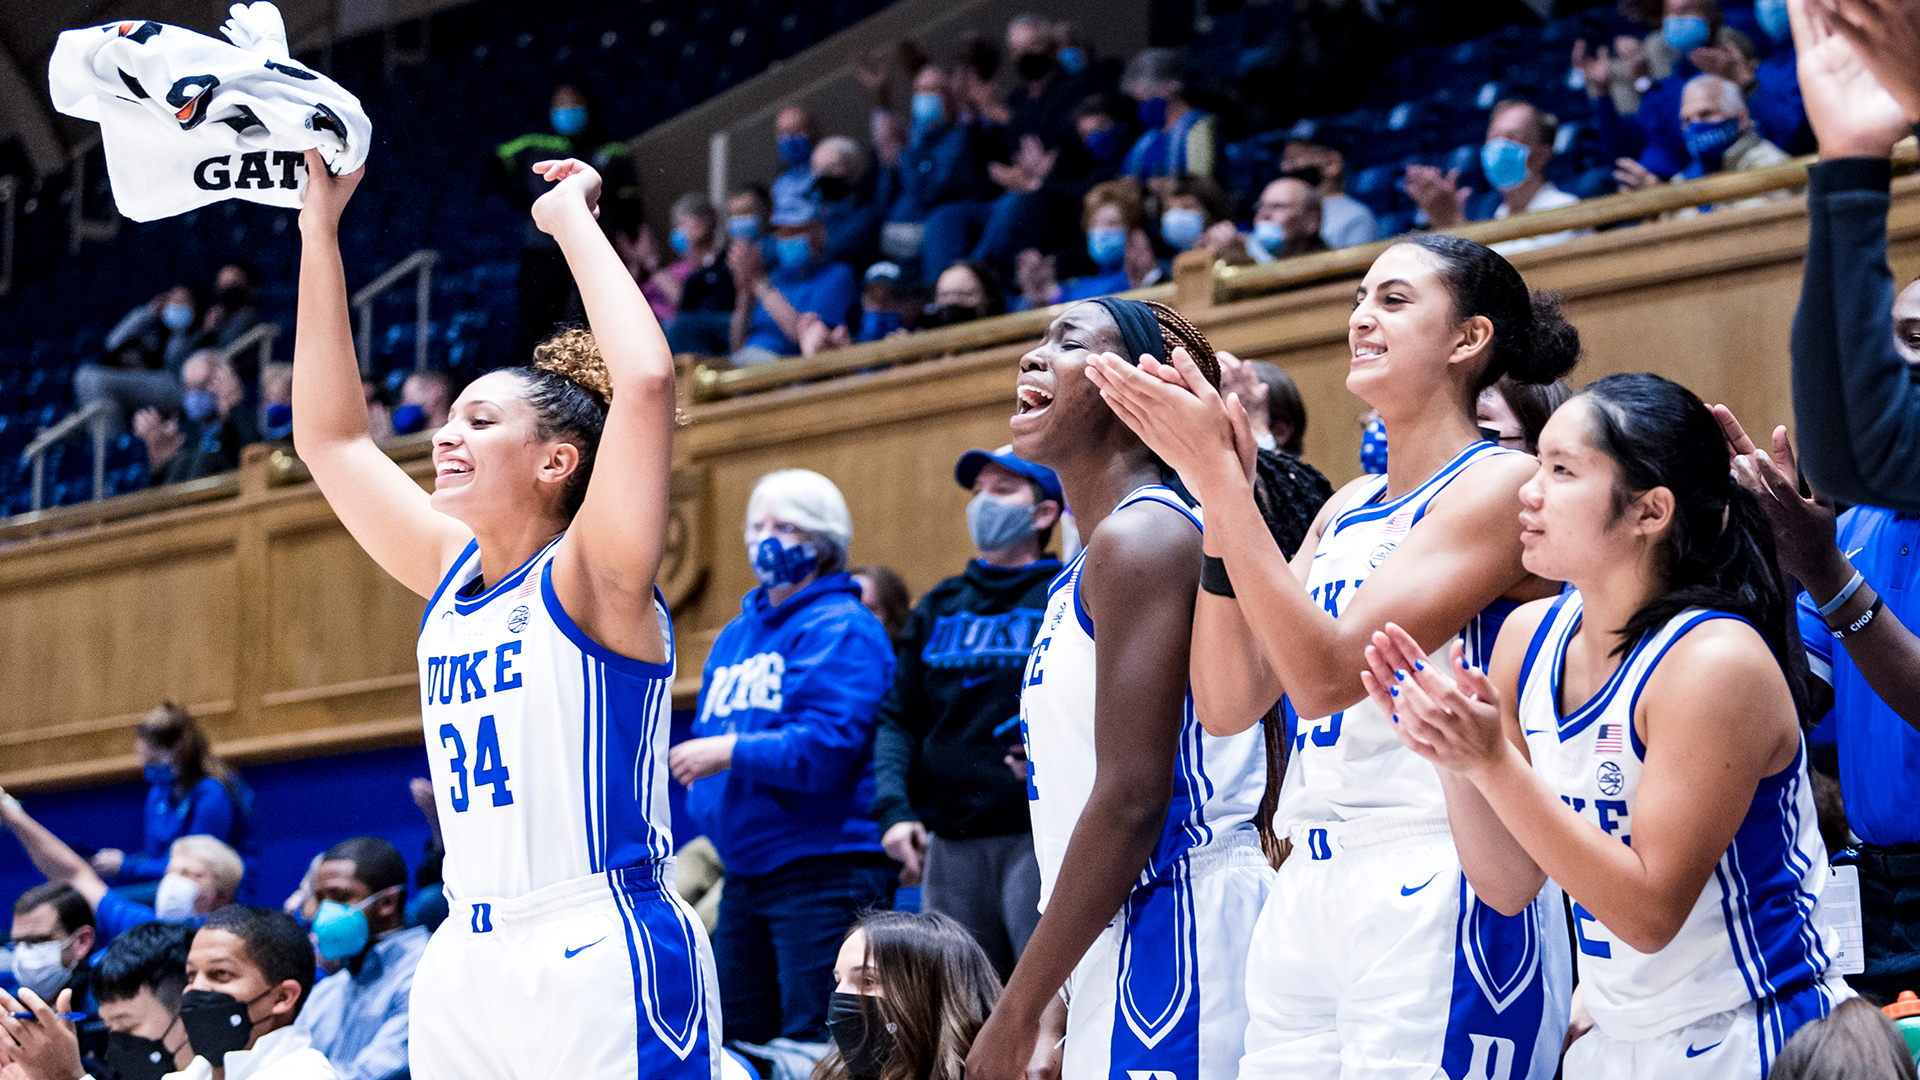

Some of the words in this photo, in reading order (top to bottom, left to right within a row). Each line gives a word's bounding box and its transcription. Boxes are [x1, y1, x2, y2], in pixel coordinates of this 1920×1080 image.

[193, 150, 309, 191] GAT
[1849, 609, 1874, 632] CHOP
[428, 640, 523, 706] DUKE
[439, 714, 514, 813] 34
